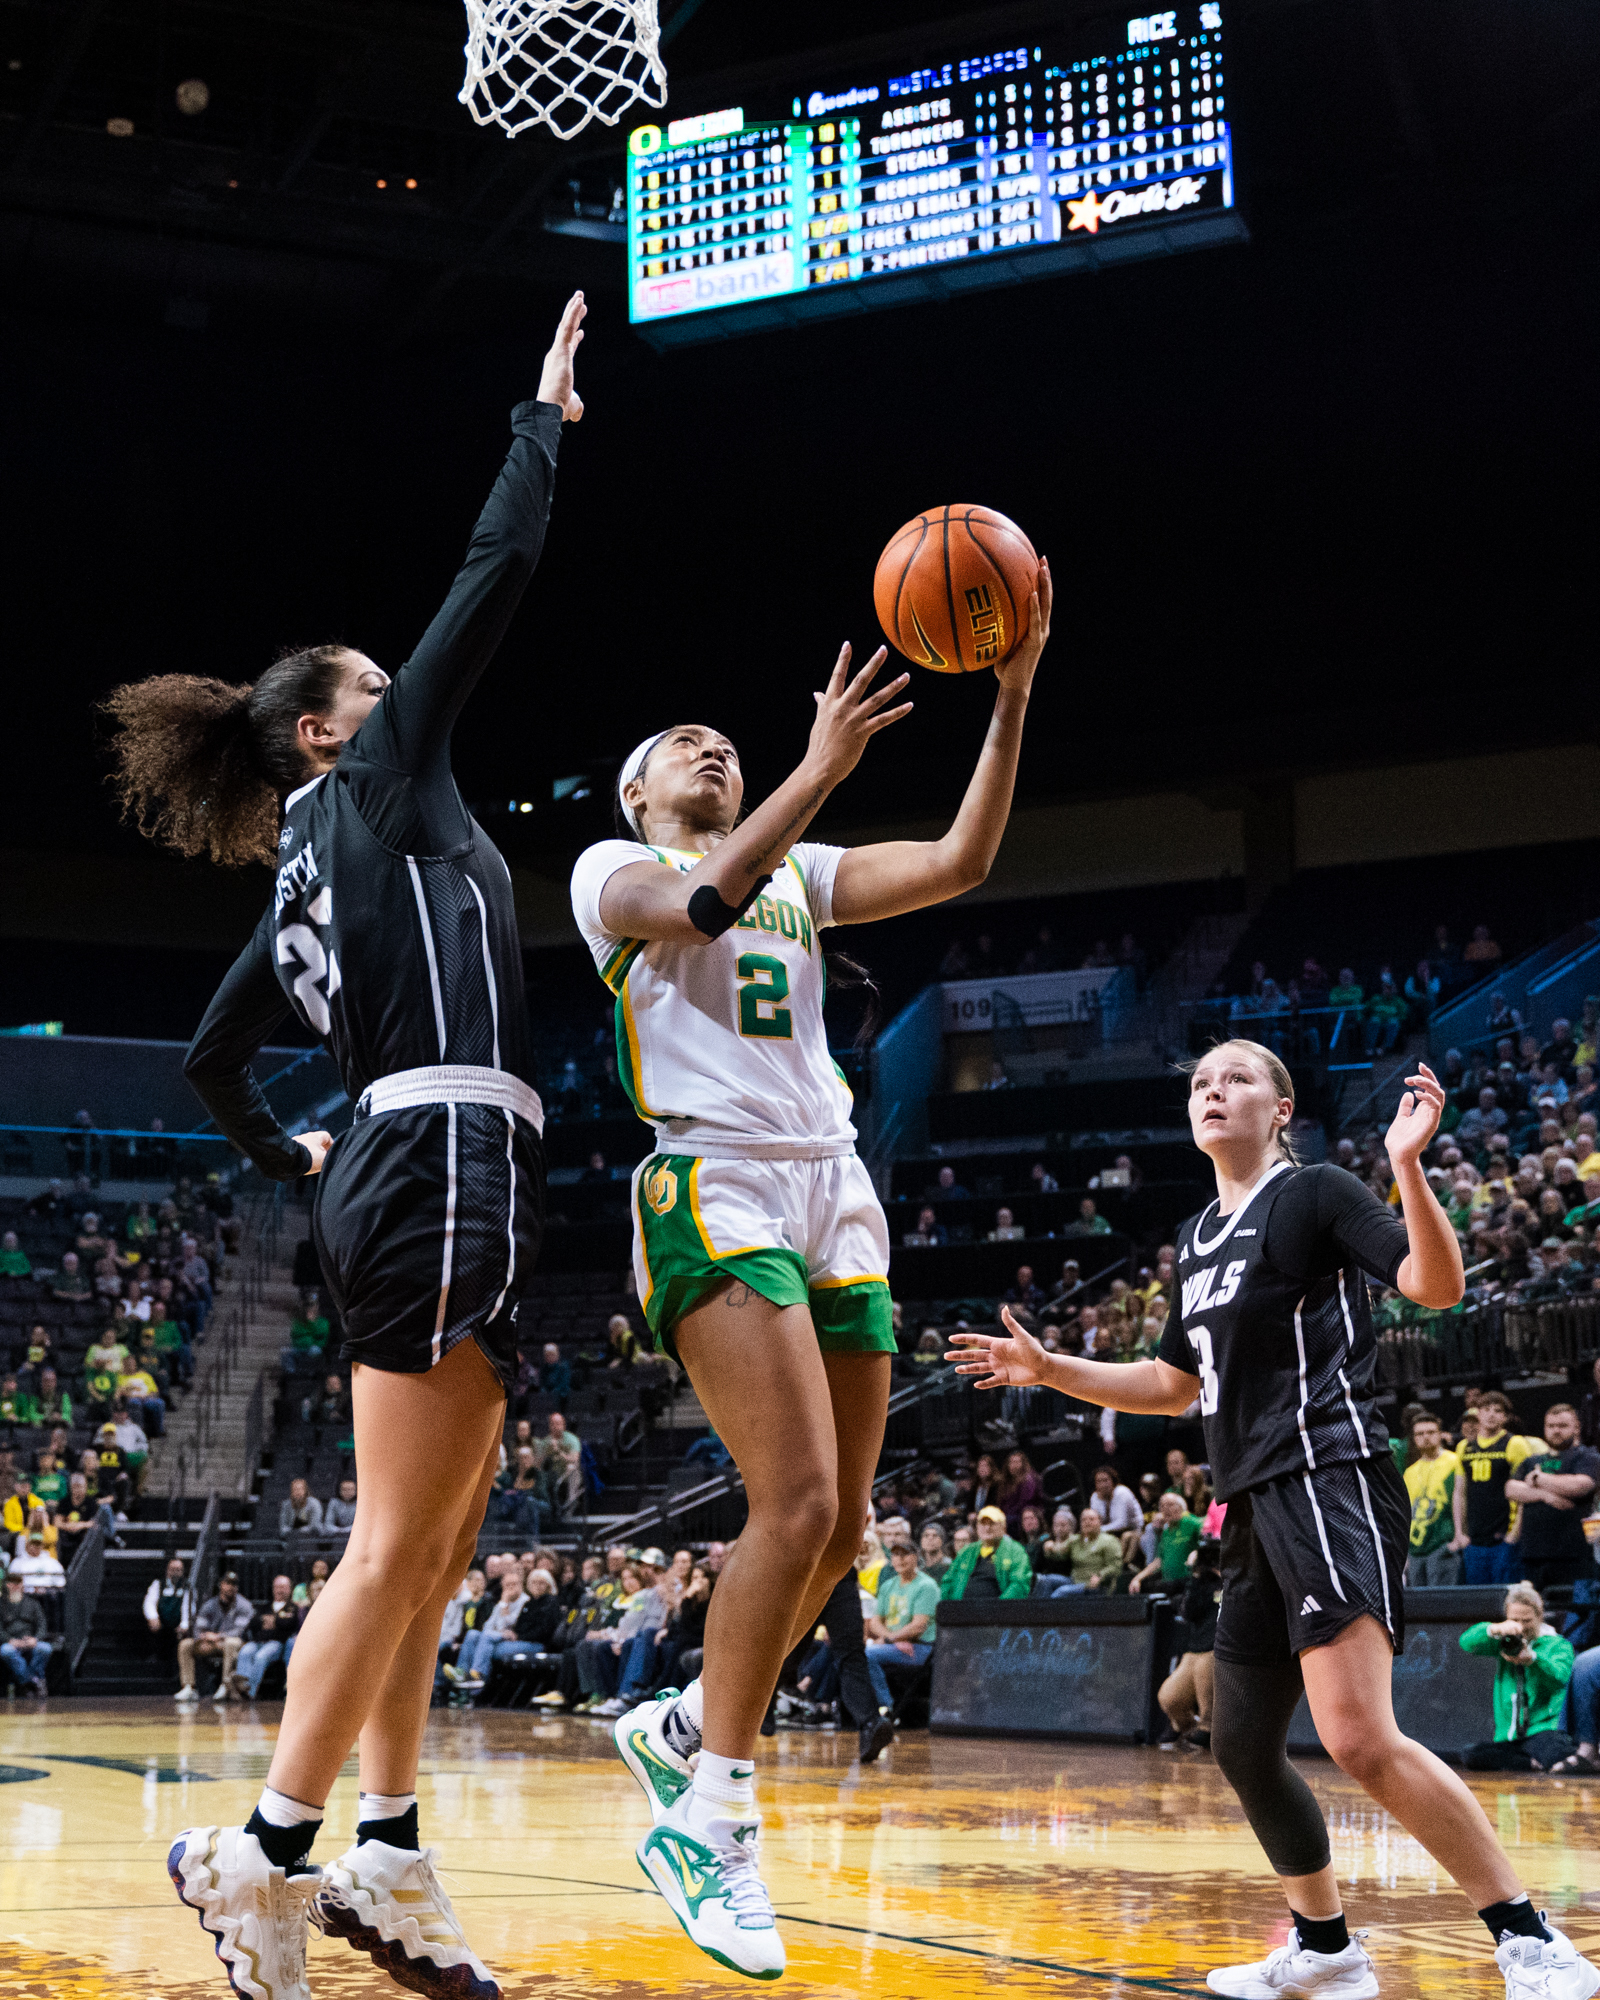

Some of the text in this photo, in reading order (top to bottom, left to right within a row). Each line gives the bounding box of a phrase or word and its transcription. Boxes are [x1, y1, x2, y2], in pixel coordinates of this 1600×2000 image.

[1127, 11, 1177, 45] RICE
[887, 63, 953, 97] HUSTLE
[881, 97, 951, 129] ASSISTS
[870, 119, 965, 155] TURNOVERS
[886, 145, 949, 176] STEALS
[866, 200, 915, 227] FIELD
[916, 188, 971, 217] GOALS
[864, 225, 907, 251] FREE
[695, 262, 781, 300] bank
[964, 583, 999, 664] ELITE
[729, 892, 813, 960] EGON
[735, 950, 794, 1041] 2
[951, 998, 991, 1020] 109
[1181, 1259, 1247, 1321] WLS
[1469, 1459, 1492, 1482] 10
